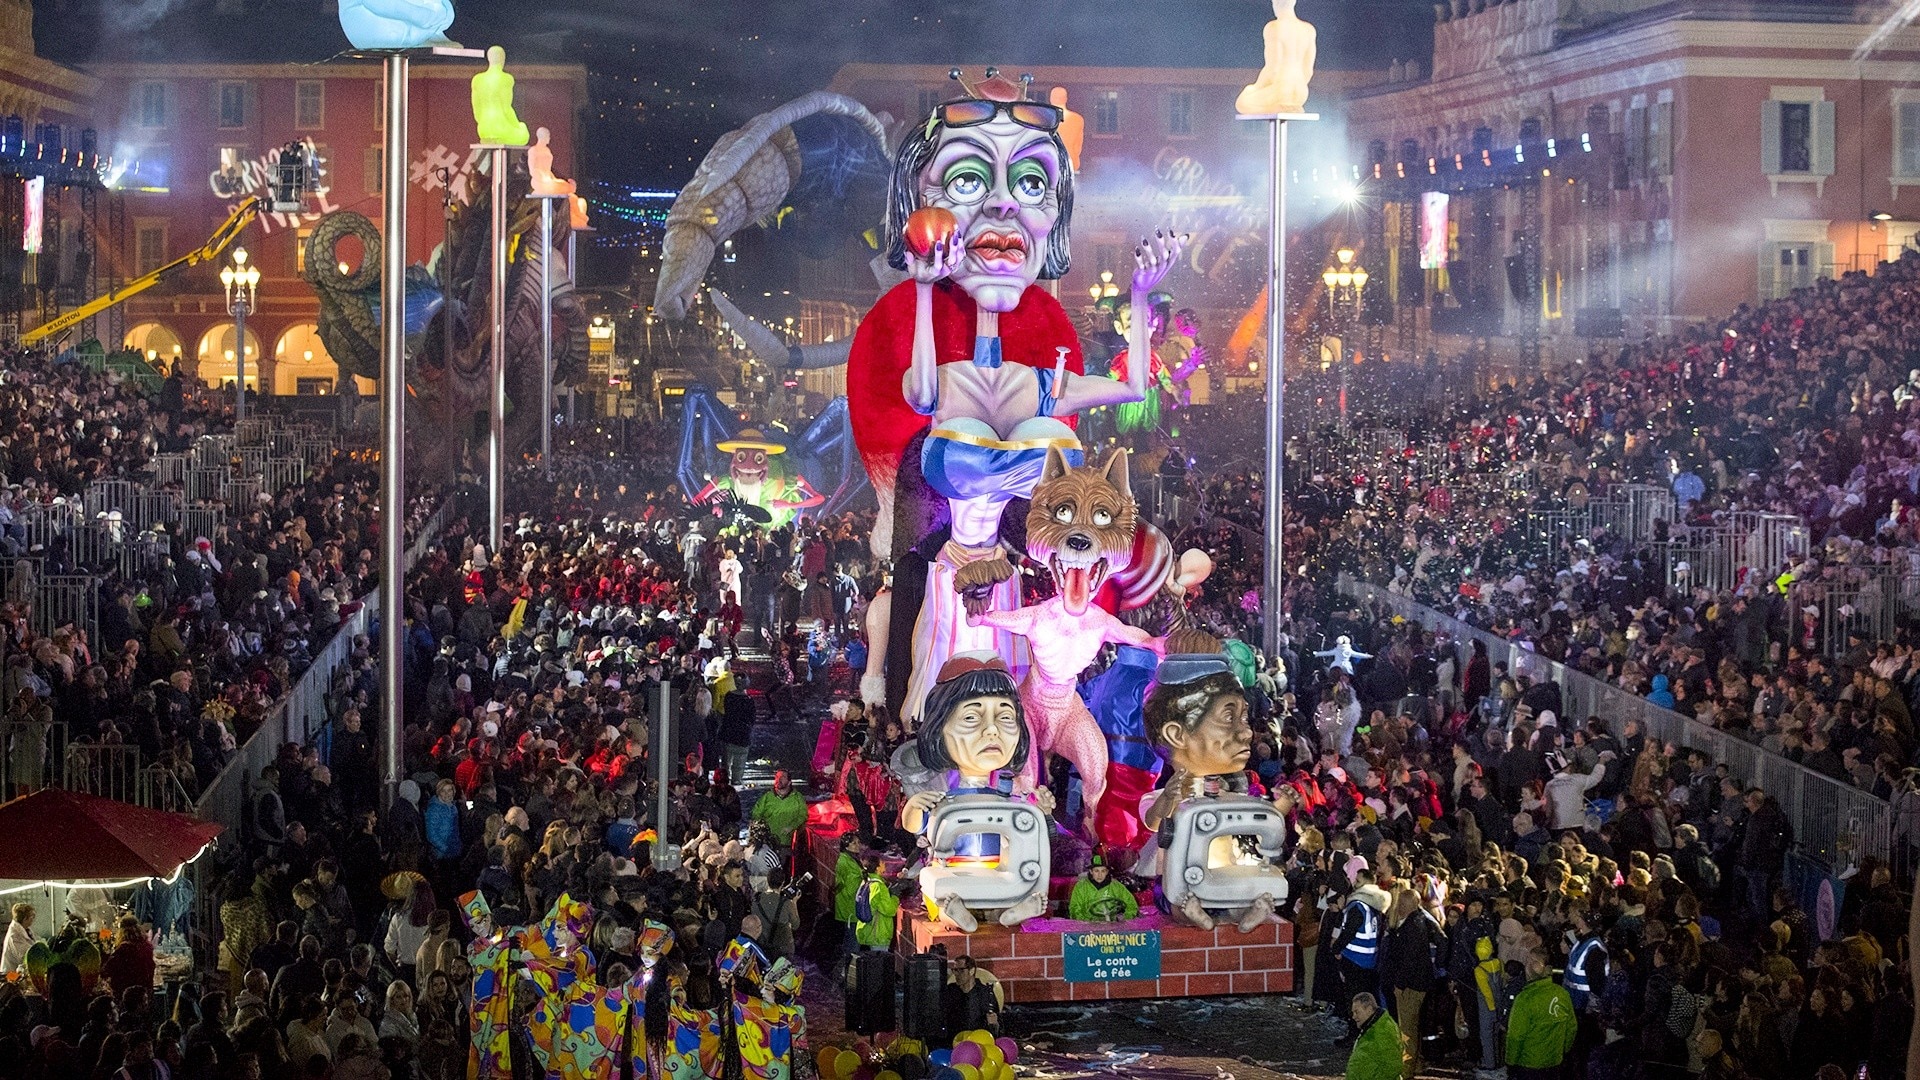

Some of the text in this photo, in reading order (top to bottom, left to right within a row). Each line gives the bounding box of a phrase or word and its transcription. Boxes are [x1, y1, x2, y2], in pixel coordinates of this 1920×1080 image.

[1079, 933, 1146, 947] CARNAVAL NICE
[1087, 956, 1138, 966] Le conte
[1094, 967, 1131, 977] de fée
